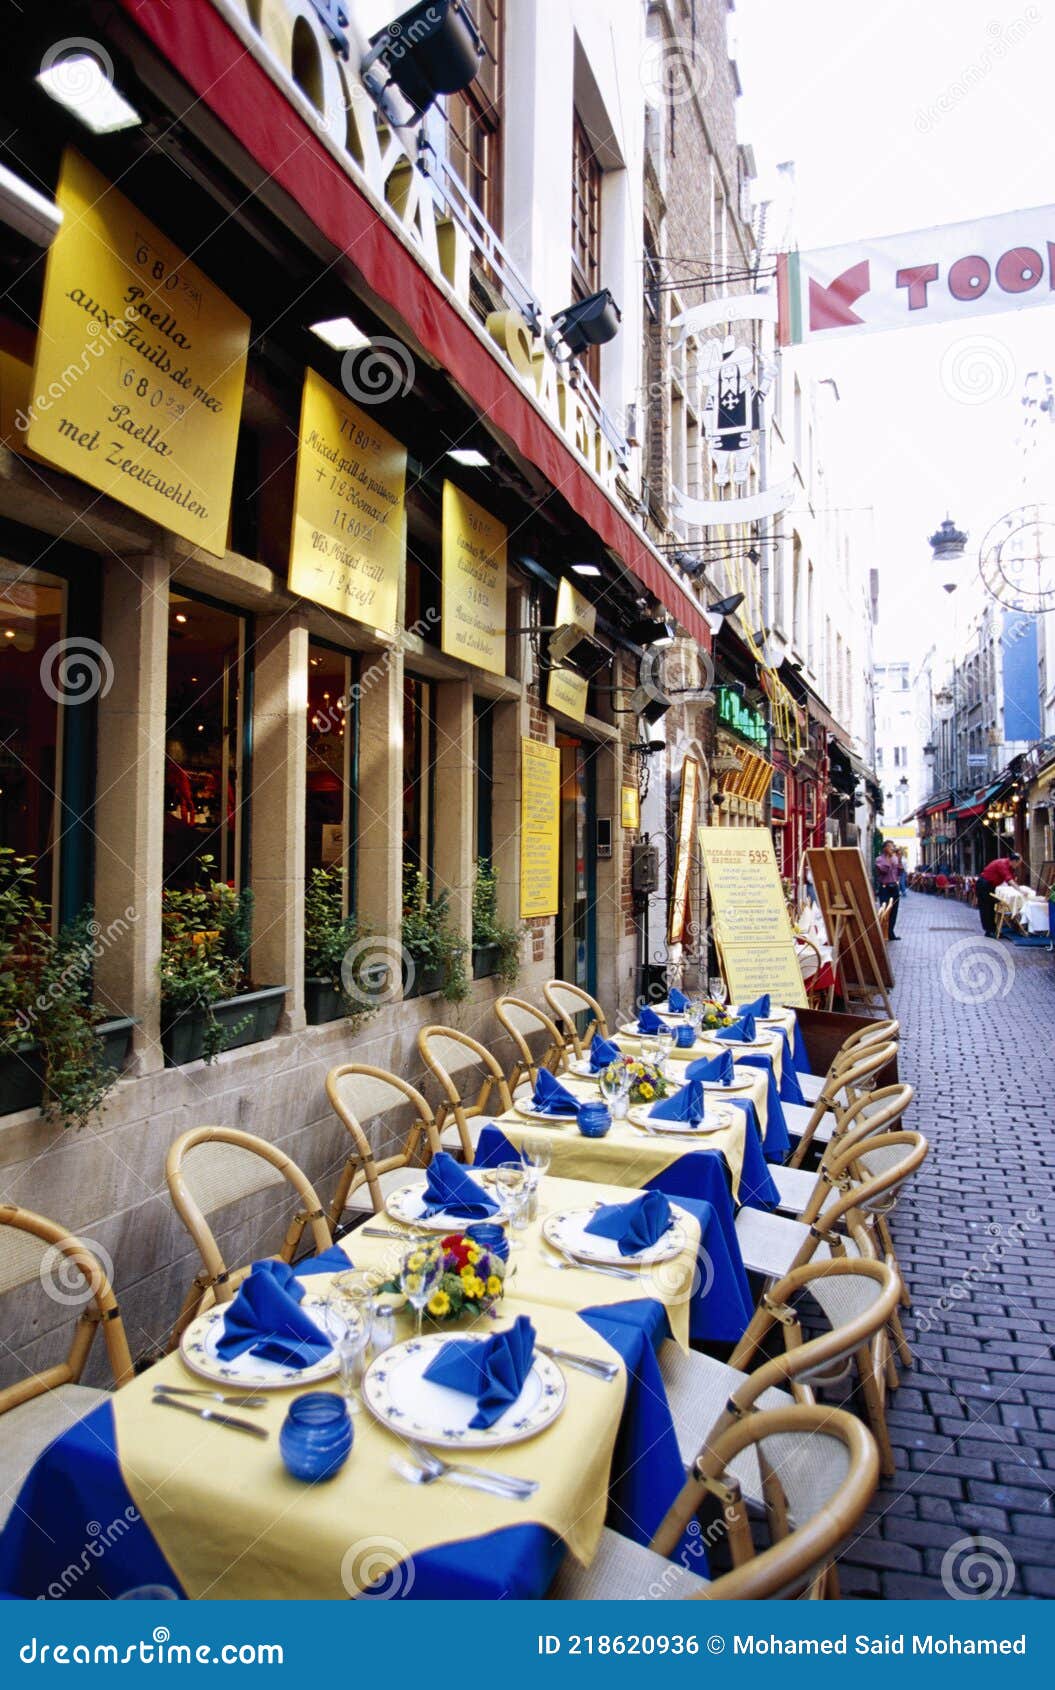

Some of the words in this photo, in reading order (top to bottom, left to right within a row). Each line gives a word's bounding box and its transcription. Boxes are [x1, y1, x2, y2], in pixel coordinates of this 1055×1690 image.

[123, 285, 192, 350] Paella
[66, 288, 115, 329] aux
[169, 367, 192, 390] de
[192, 385, 224, 414] mer
[58, 418, 100, 452] met
[107, 404, 173, 457] Paella
[304, 430, 339, 461] Mixed
